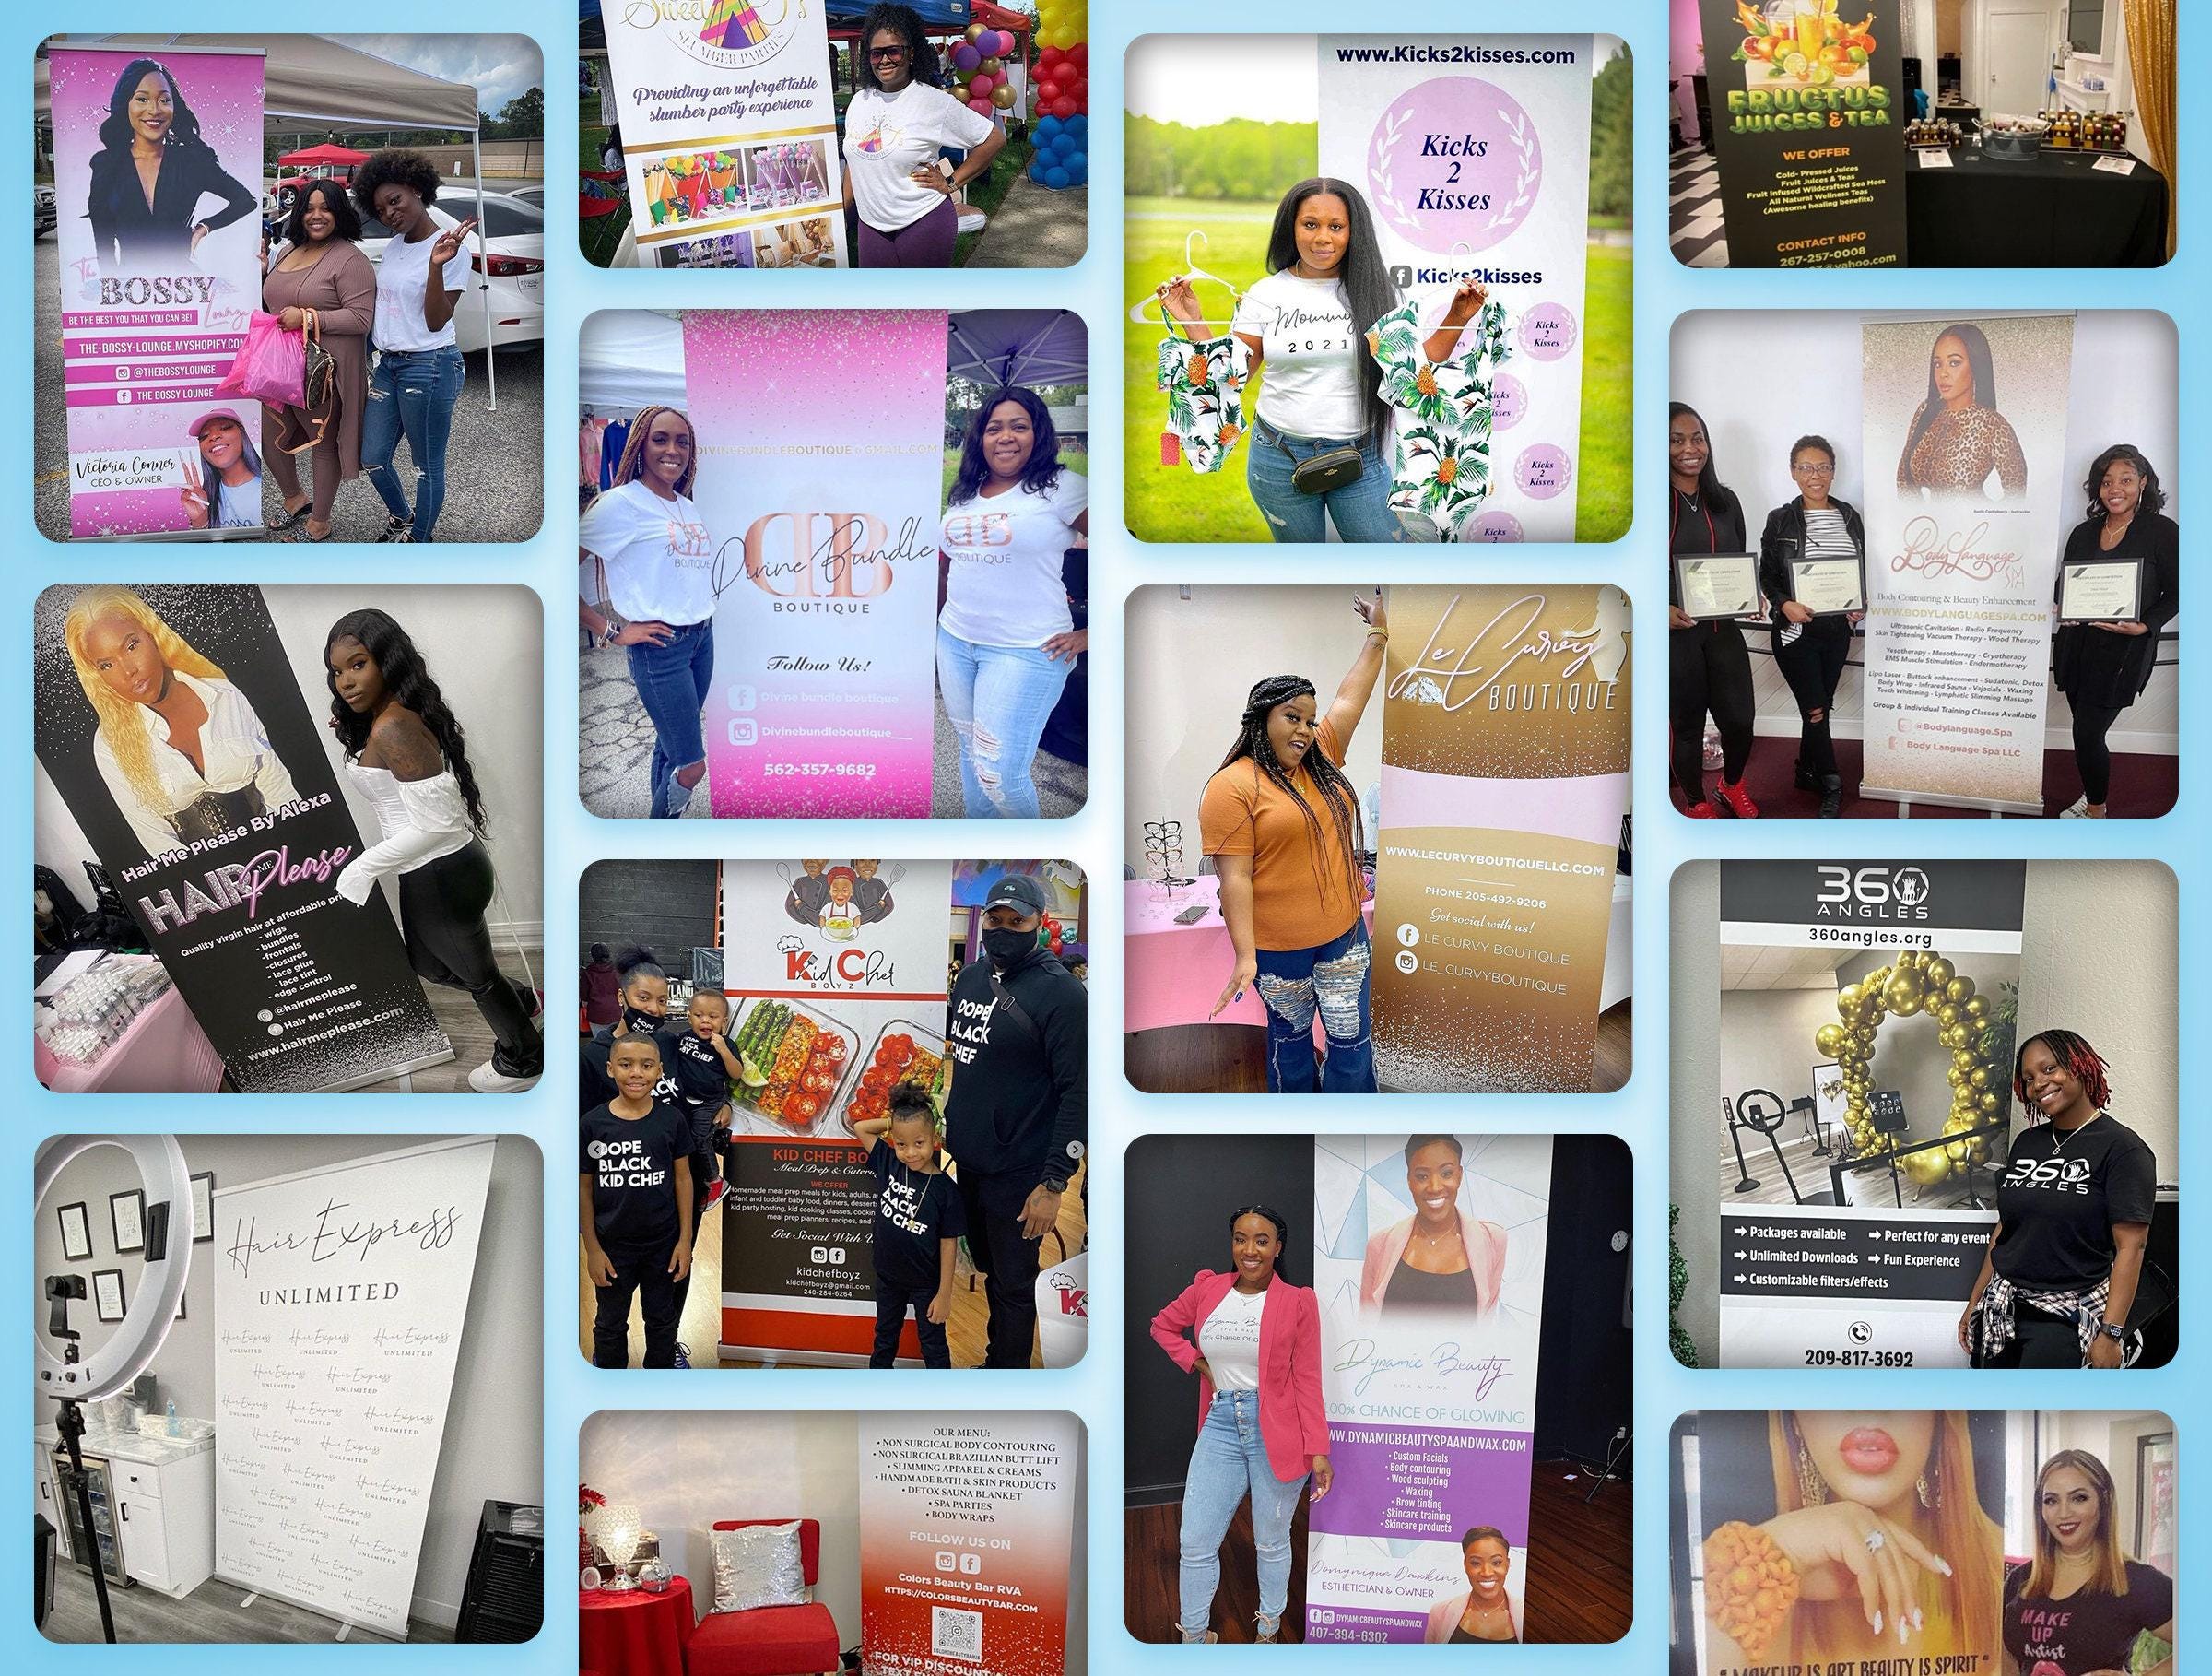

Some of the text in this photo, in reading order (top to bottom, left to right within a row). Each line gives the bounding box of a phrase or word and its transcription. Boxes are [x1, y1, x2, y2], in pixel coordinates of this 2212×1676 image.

[677, 30, 786, 65] SLUMBER PARTIES
[1336, 46, 1575, 64] www.Kicks2kisses.com
[633, 76, 818, 105] Providing an unforgettable
[1727, 86, 1891, 114] FRUCTUS
[649, 99, 813, 122] slumber party experience
[1729, 110, 1890, 133] JUICES & TEA
[1421, 135, 1488, 157] Kicks
[1783, 148, 1850, 160] WE OFFER
[1446, 162, 1461, 183] 2
[1417, 189, 1490, 210] Kisses
[1777, 232, 1866, 252] CONTACT INFO
[1780, 247, 1866, 267] 267-257-0008
[1418, 269, 1543, 284] Kicks2kisses
[100, 277, 216, 305] BOSSY
[96, 315, 113, 324] BEST
[115, 315, 129, 324] YOU
[204, 293, 252, 330] Lounge
[1274, 306, 1356, 336] Mommy
[1535, 321, 1559, 329] Kicks
[1534, 338, 1560, 347] Kisses
[134, 366, 216, 378] @THEBOSSYLOUNGE
[137, 389, 213, 400] THE BOSSY LOUNGE
[76, 457, 175, 478] Victoria Conner
[91, 478, 111, 487] CEO
[125, 476, 162, 485] OWNER
[1891, 516, 2022, 580] Body Language
[712, 517, 935, 600] Divine Bundle
[2006, 566, 2025, 589] SPA
[774, 603, 870, 615] BOUTIQUE
[1877, 593, 1896, 601] Body
[1898, 594, 1941, 604] Contouring
[1953, 596, 1979, 605] Beauty
[1983, 596, 2036, 605] Enhancement
[1871, 608, 2047, 622] WWW.BODYLANGUAGESPA.COM
[1388, 595, 1606, 711] Le Curvy
[767, 656, 872, 672] Follow Us!
[1489, 683, 1617, 714] BOUTIQUE
[764, 764, 876, 776] 562-357-9682
[122, 792, 332, 884] Hair Me Please By Alexa
[1385, 847, 1605, 876] WWW.LECURVYBOUTIQUELLC.COM
[138, 845, 352, 935] HAIR ME Please
[1817, 865, 1929, 905] 360
[1425, 887, 1547, 909] PHONE 205-492-9206
[1817, 904, 1929, 919] ANGLES
[181, 900, 326, 958] Quality virgin hair at affordable
[1809, 928, 1932, 948] 360angles.org
[1425, 934, 1571, 966] LE CURVY BOUTIQUE
[787, 950, 835, 988] Kid
[1423, 961, 1567, 995] LE_CURVYBOUTIQUE
[275, 982, 358, 1016] @hairmeplease
[957, 998, 991, 1021] DOPE
[246, 1007, 404, 1062] www.hairmeplease.com
[950, 1020, 991, 1044] BLACK
[599, 1157, 652, 1172] BLACK
[773, 1150, 842, 1162] KID CHEF
[599, 1171, 665, 1187] KID CHEF
[774, 1163, 830, 1175] Meal Prep
[2002, 1180, 2088, 1195] ANGLES
[227, 1198, 463, 1279] Hair Express
[1750, 1226, 1846, 1240] Packages available
[1884, 1230, 1990, 1245] Perfect for any event
[1750, 1250, 1858, 1264] Unlimited Downloads
[1884, 1254, 1960, 1268] Fun Experience
[797, 1267, 861, 1280] kidchefboyz
[1750, 1273, 1888, 1289] Customizable filters/effects
[260, 1282, 400, 1305] UNLIMITED
[786, 1280, 870, 1290] kidchefboyz@gmail.com
[373, 1327, 451, 1346] Hair Express
[1806, 1350, 1913, 1367] 209-817-3692
[1333, 1339, 1514, 1402] Dynamic Beauty
[1325, 1403, 1525, 1424] 00% CHANCE OF GLOWING
[934, 1428, 991, 1437] OUR MENU:
[1329, 1430, 1526, 1452] WW.DYNAMICBEAUTYSPAANDWAX.COM
[905, 1440, 952, 1448] SURGICAL
[954, 1441, 982, 1449] BODY
[983, 1442, 1056, 1452] CONTOURING
[1394, 1451, 1449, 1462] Custom Facials
[910, 1531, 1011, 1550] FOLLOW US ON
[899, 1573, 1022, 1596] Colors Beauty Bar RVA
[1322, 1582, 1434, 1598] ESTHETICIAN & OWNER
[885, 1587, 1038, 1613] HTTPS://COLORSBEAUTYBAR.COM
[2020, 1610, 2073, 1626] MAKE
[1310, 1627, 1388, 1643] 407-394-6302
[2031, 1626, 2053, 1643] UP
[2024, 1644, 2066, 1659] Artist
[1861, 1655, 1980, 1676] BEAUTY IS SPIRIT
